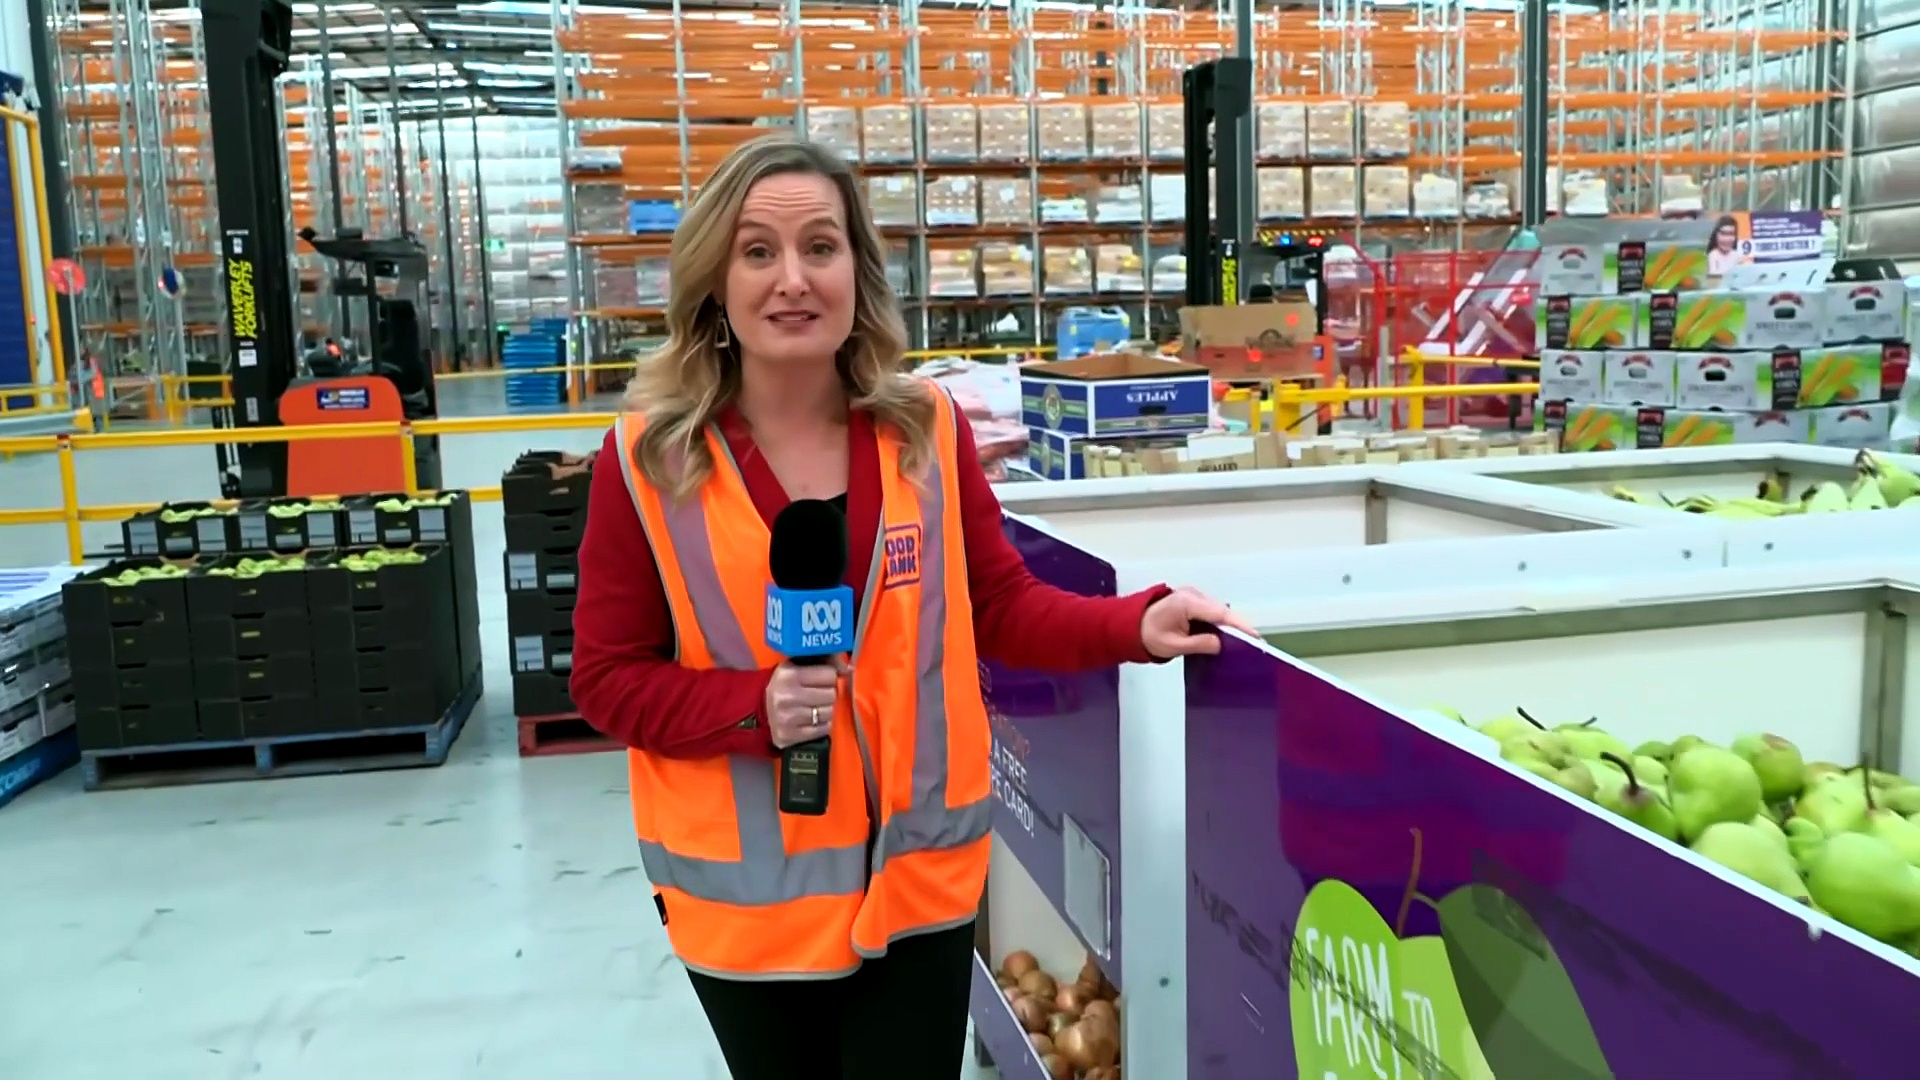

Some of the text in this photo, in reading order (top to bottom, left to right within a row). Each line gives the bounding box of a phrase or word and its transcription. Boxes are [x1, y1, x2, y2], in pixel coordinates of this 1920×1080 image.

[228, 258, 246, 336] WAVERLEY
[240, 260, 258, 339] FORKLIFTS
[1126, 390, 1179, 403] APPLES
[885, 536, 916, 558] OOD
[888, 555, 917, 577] ANK
[802, 632, 842, 648] NEWS
[1002, 746, 1027, 788] FREE
[1003, 782, 1035, 838] CARD!
[1305, 927, 1400, 1080] FARM
